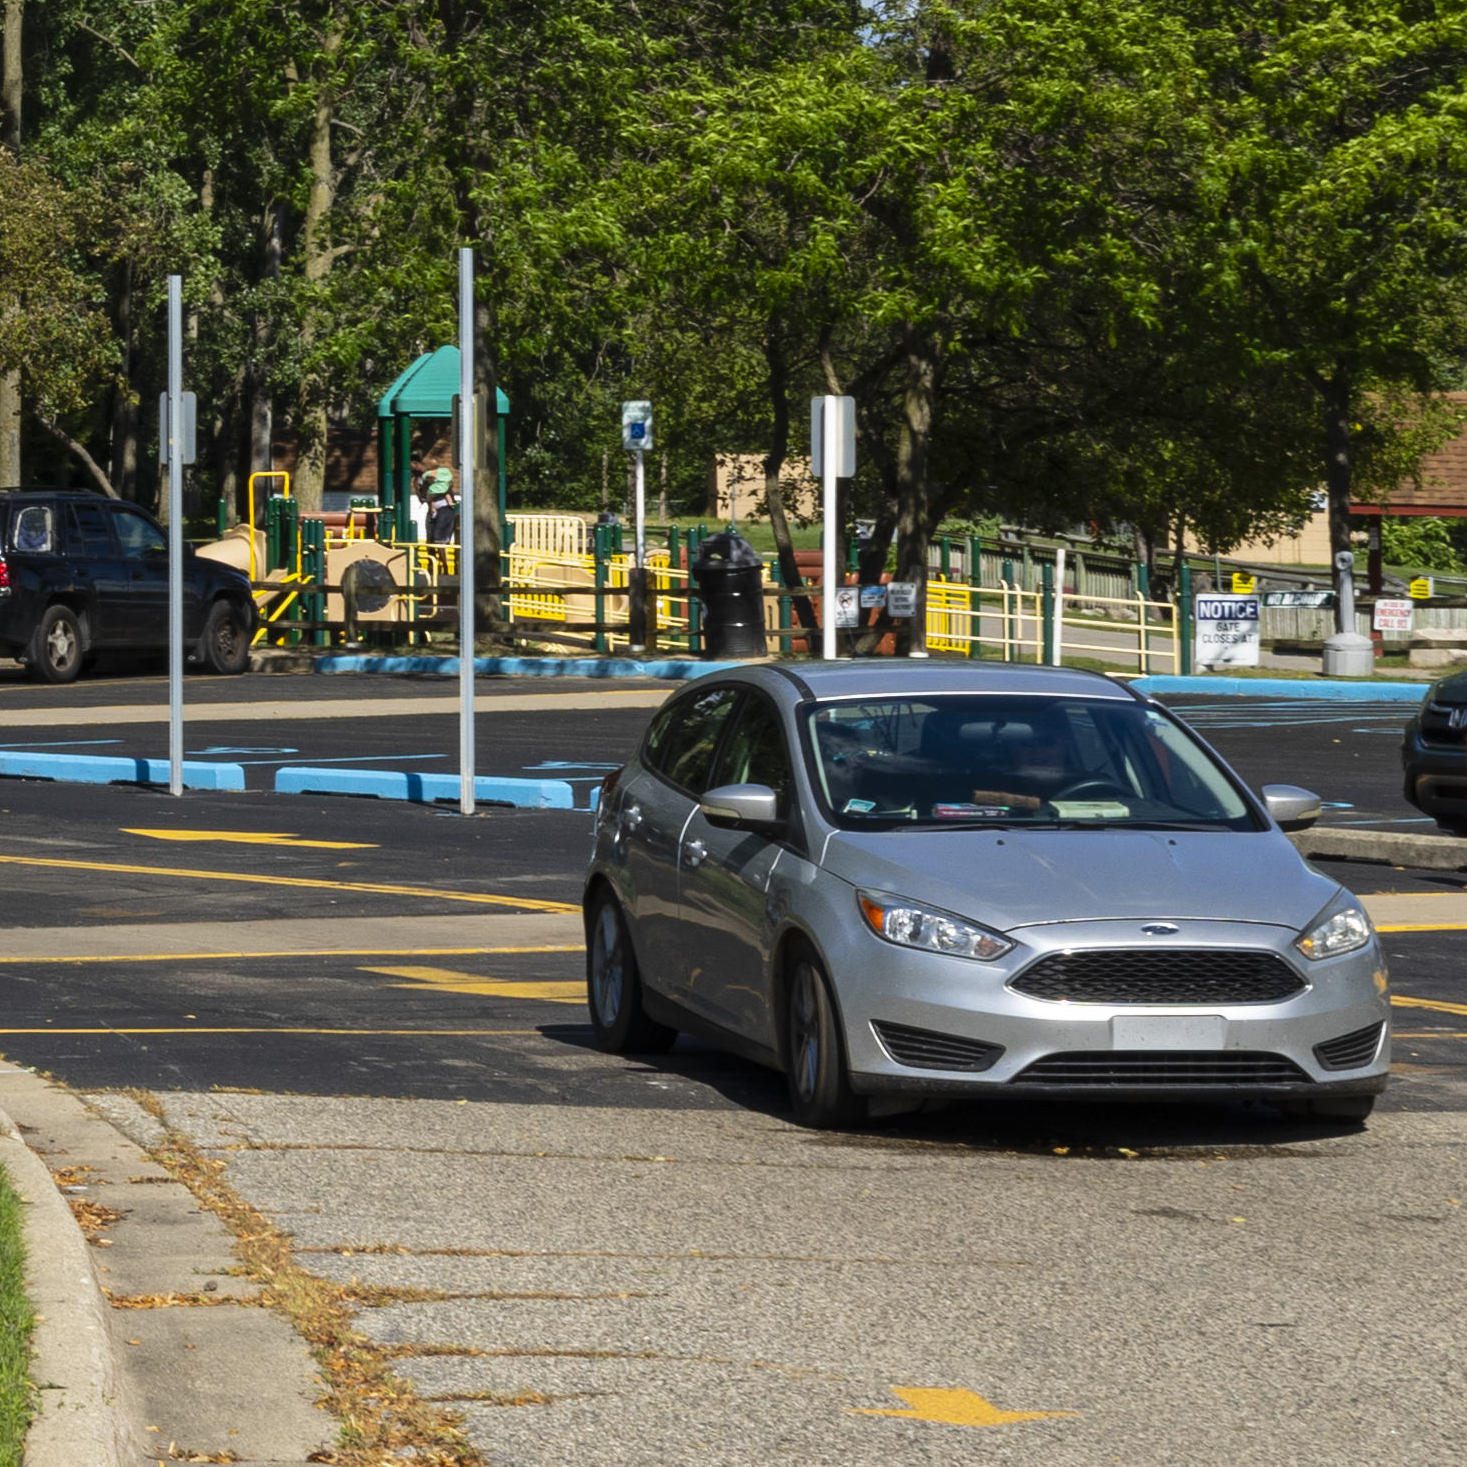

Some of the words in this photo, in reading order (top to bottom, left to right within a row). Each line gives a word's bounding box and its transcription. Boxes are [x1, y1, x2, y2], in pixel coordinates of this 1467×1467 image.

[1199, 601, 1257, 619] NOTICE
[1216, 622, 1240, 632] GATE
[1202, 634, 1238, 644] CLOSES
[1241, 634, 1253, 643] AT
